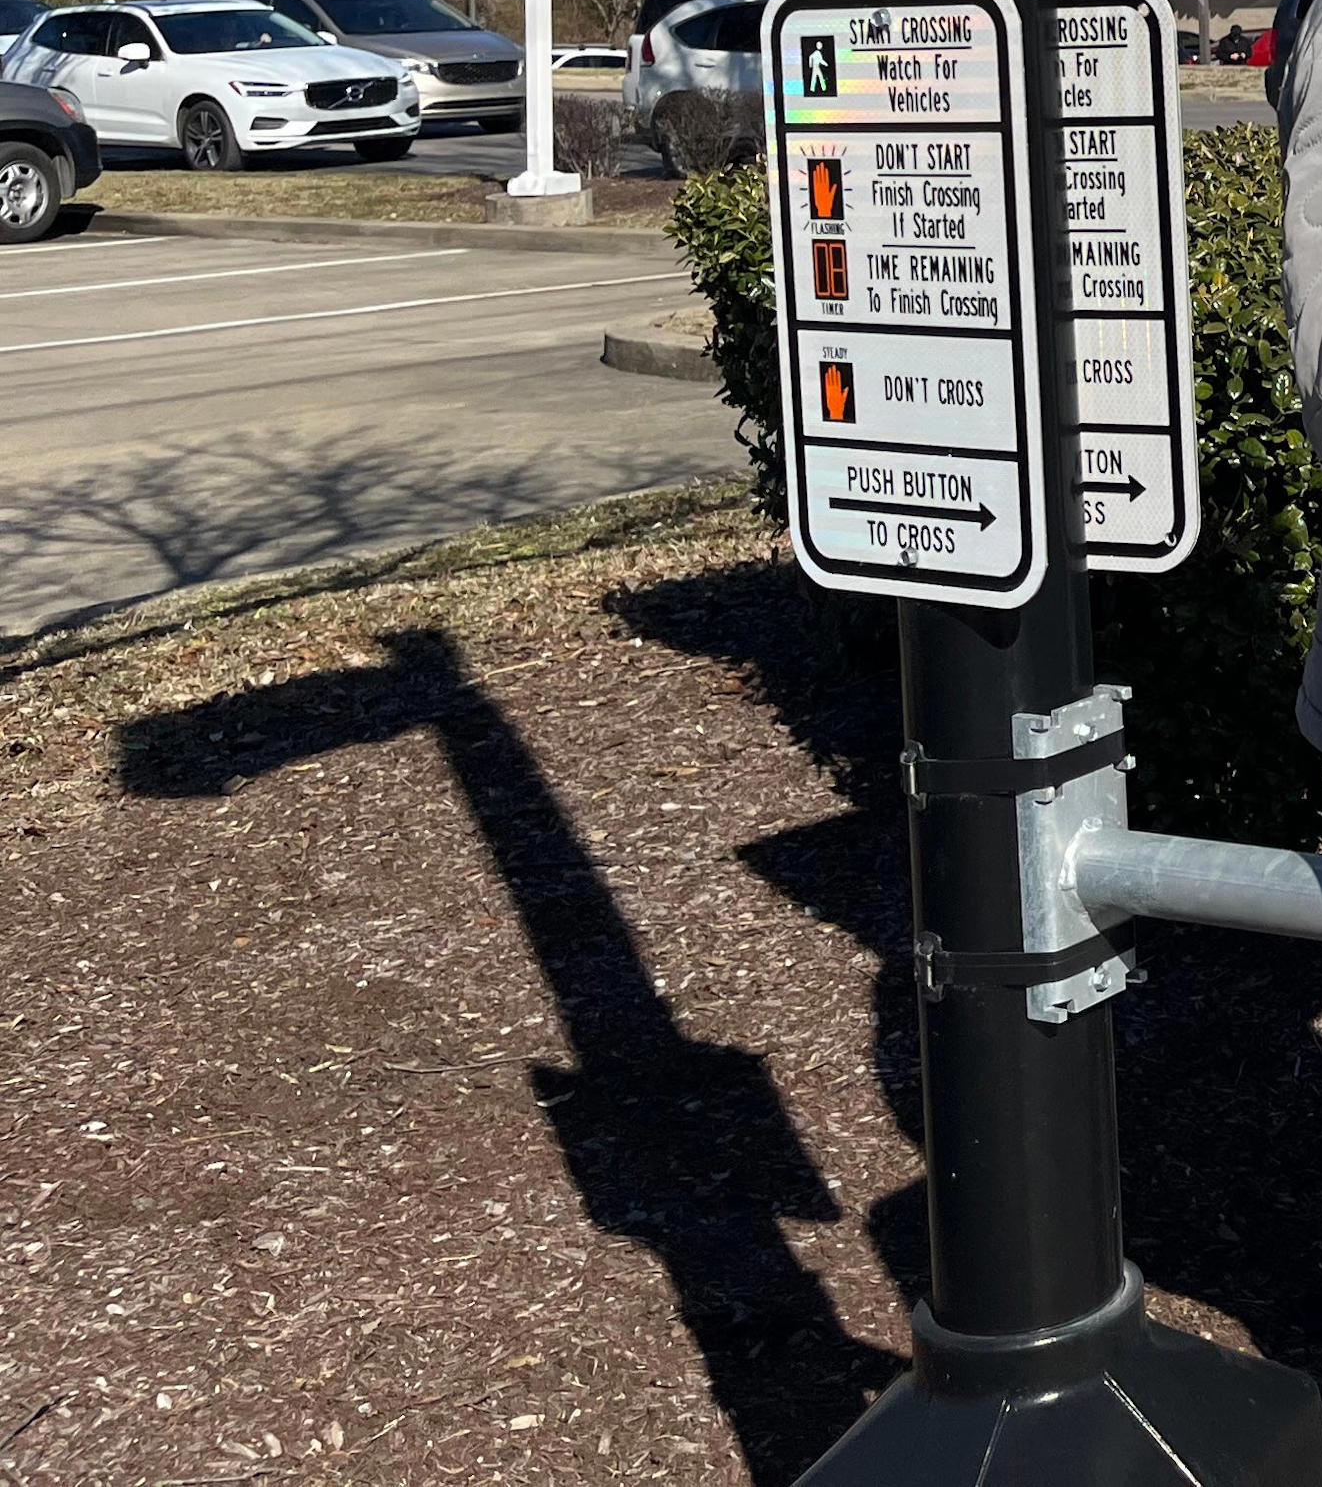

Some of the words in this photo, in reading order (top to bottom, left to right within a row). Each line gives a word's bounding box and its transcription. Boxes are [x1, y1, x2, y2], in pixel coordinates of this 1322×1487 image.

[850, 18, 891, 44] START
[902, 15, 972, 44] CROSSING
[1057, 16, 1128, 44] ROSSING
[877, 54, 921, 81] Watch
[935, 54, 958, 79] For
[1076, 52, 1099, 78] For
[888, 86, 950, 113] Vehicles
[1069, 130, 1116, 155] START
[876, 143, 918, 170] DON'T
[927, 144, 971, 170] START
[872, 180, 913, 206] Finish
[923, 180, 980, 216] Crossing
[1068, 196, 1105, 220] arted
[811, 223, 845, 235] FLASHING
[893, 212, 904, 238] If
[914, 212, 965, 239] Started
[1072, 242, 1141, 266] MAINING
[867, 254, 900, 280] TIME
[911, 256, 994, 283] REMAINING
[1083, 273, 1144, 306] Crossing
[822, 302, 844, 315] TIMER
[867, 287, 880, 313] To
[891, 288, 931, 315] Finish
[941, 289, 998, 326] Crossing
[822, 346, 848, 359] STEADY
[1083, 359, 1133, 385] CROSS
[884, 375, 928, 403] DON'T
[938, 378, 984, 407] CROSS
[847, 466, 894, 495] PUSH
[903, 471, 972, 502] BUTTON
[867, 520, 888, 547] TO
[897, 523, 956, 554] CROSS
